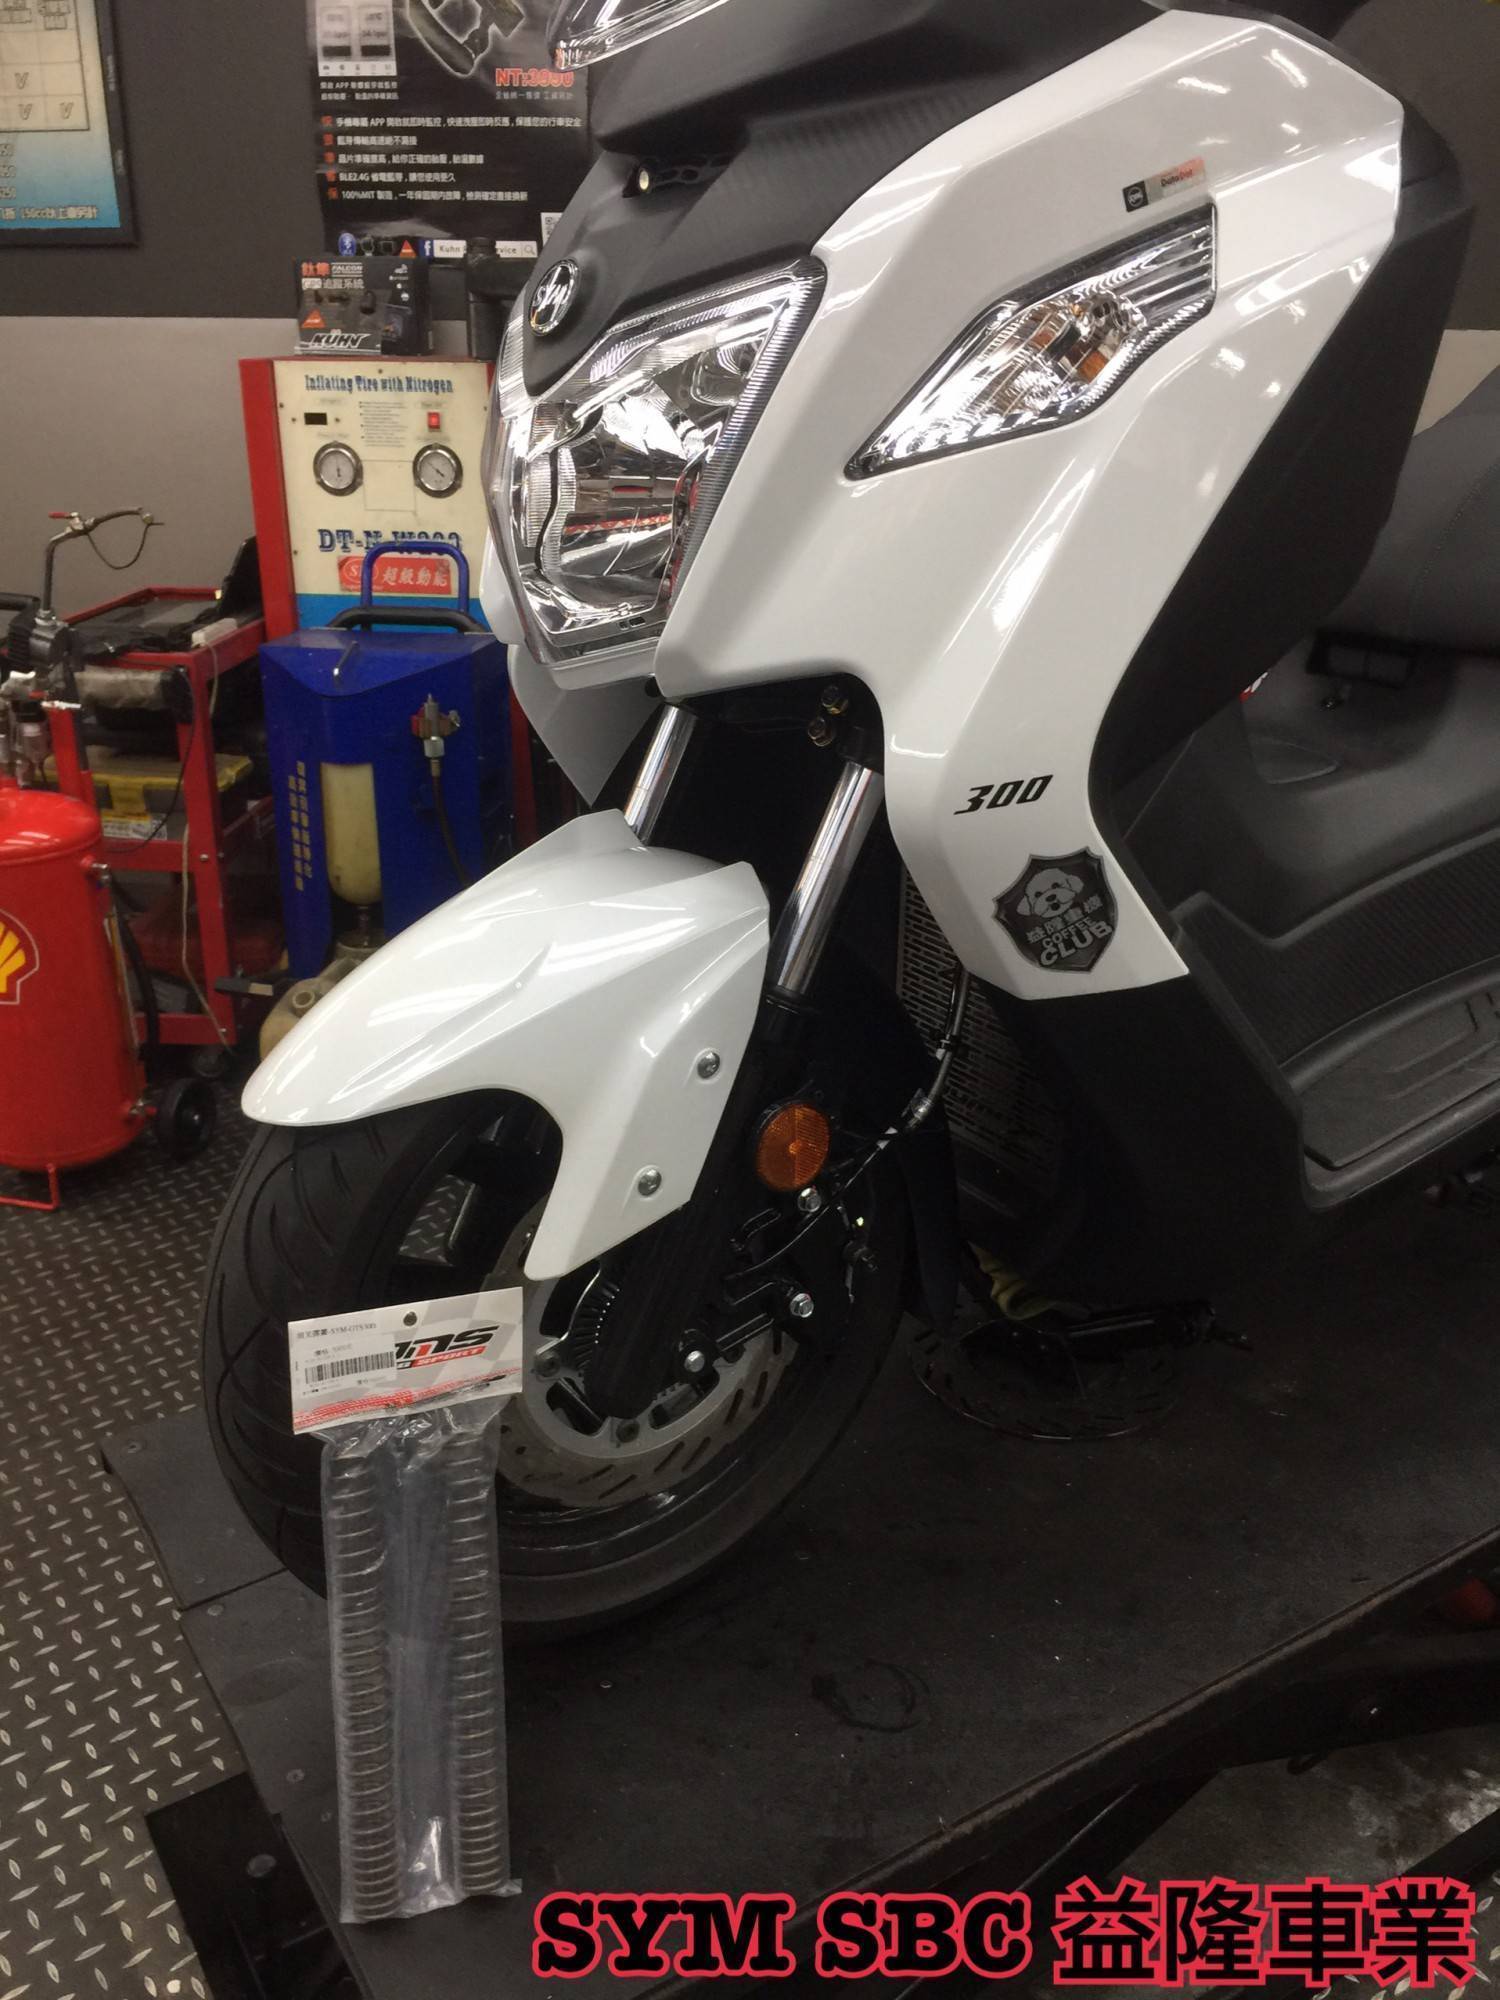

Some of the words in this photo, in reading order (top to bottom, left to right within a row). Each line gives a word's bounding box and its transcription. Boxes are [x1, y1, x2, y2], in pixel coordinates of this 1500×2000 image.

[370, 117, 386, 127] APP
[439, 244, 461, 254] Kuhn
[311, 333, 366, 348] KUHN
[304, 374, 353, 393] Inflating
[354, 375, 378, 392] Tire
[380, 376, 404, 392] with
[405, 376, 454, 395] Nitrogen
[383, 566, 448, 587] 超級動能
[953, 774, 1054, 816] 300
[1040, 920, 1113, 966] CLUB
[1042, 916, 1097, 949] COFFEE
[417, 1347, 481, 1367] SPORT
